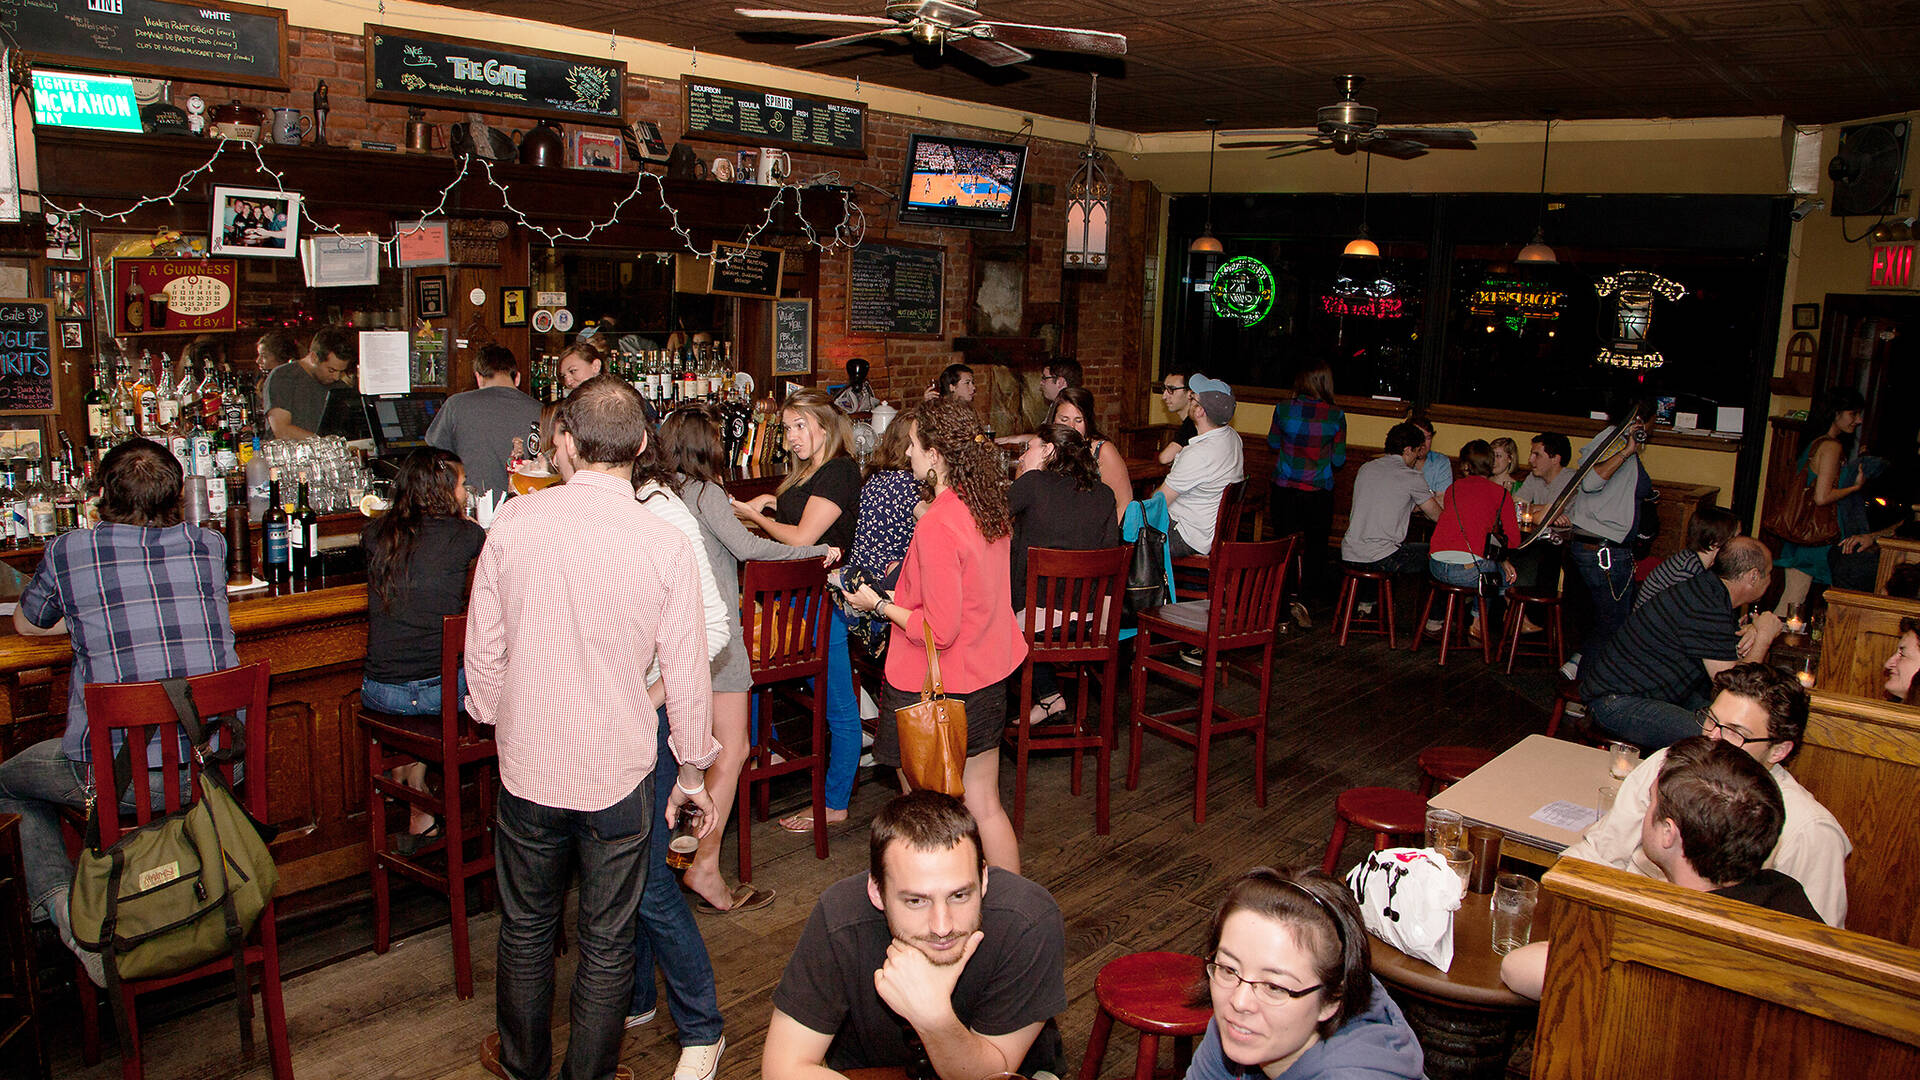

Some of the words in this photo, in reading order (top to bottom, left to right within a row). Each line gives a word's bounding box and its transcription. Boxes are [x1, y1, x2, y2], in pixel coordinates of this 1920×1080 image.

[88, 0, 123, 13] WINE
[199, 8, 231, 22] WHITE
[446, 56, 483, 81] THE
[483, 58, 527, 89] GATE
[32, 76, 89, 93] FIGHTER
[693, 85, 722, 95] BOURBON
[737, 100, 761, 110] TEQUILA
[766, 94, 793, 110] SPIRITS
[795, 110, 809, 118] IRISH
[827, 104, 840, 113] MALT
[840, 105, 861, 116] SCOTCH
[37, 111, 63, 125] WAY
[148, 265, 158, 276] A
[163, 263, 230, 276] GUINNESS
[1871, 245, 1914, 286] EXIT
[0, 306, 26, 321] Gate
[179, 318, 187, 328] a
[193, 316, 225, 328] day!
